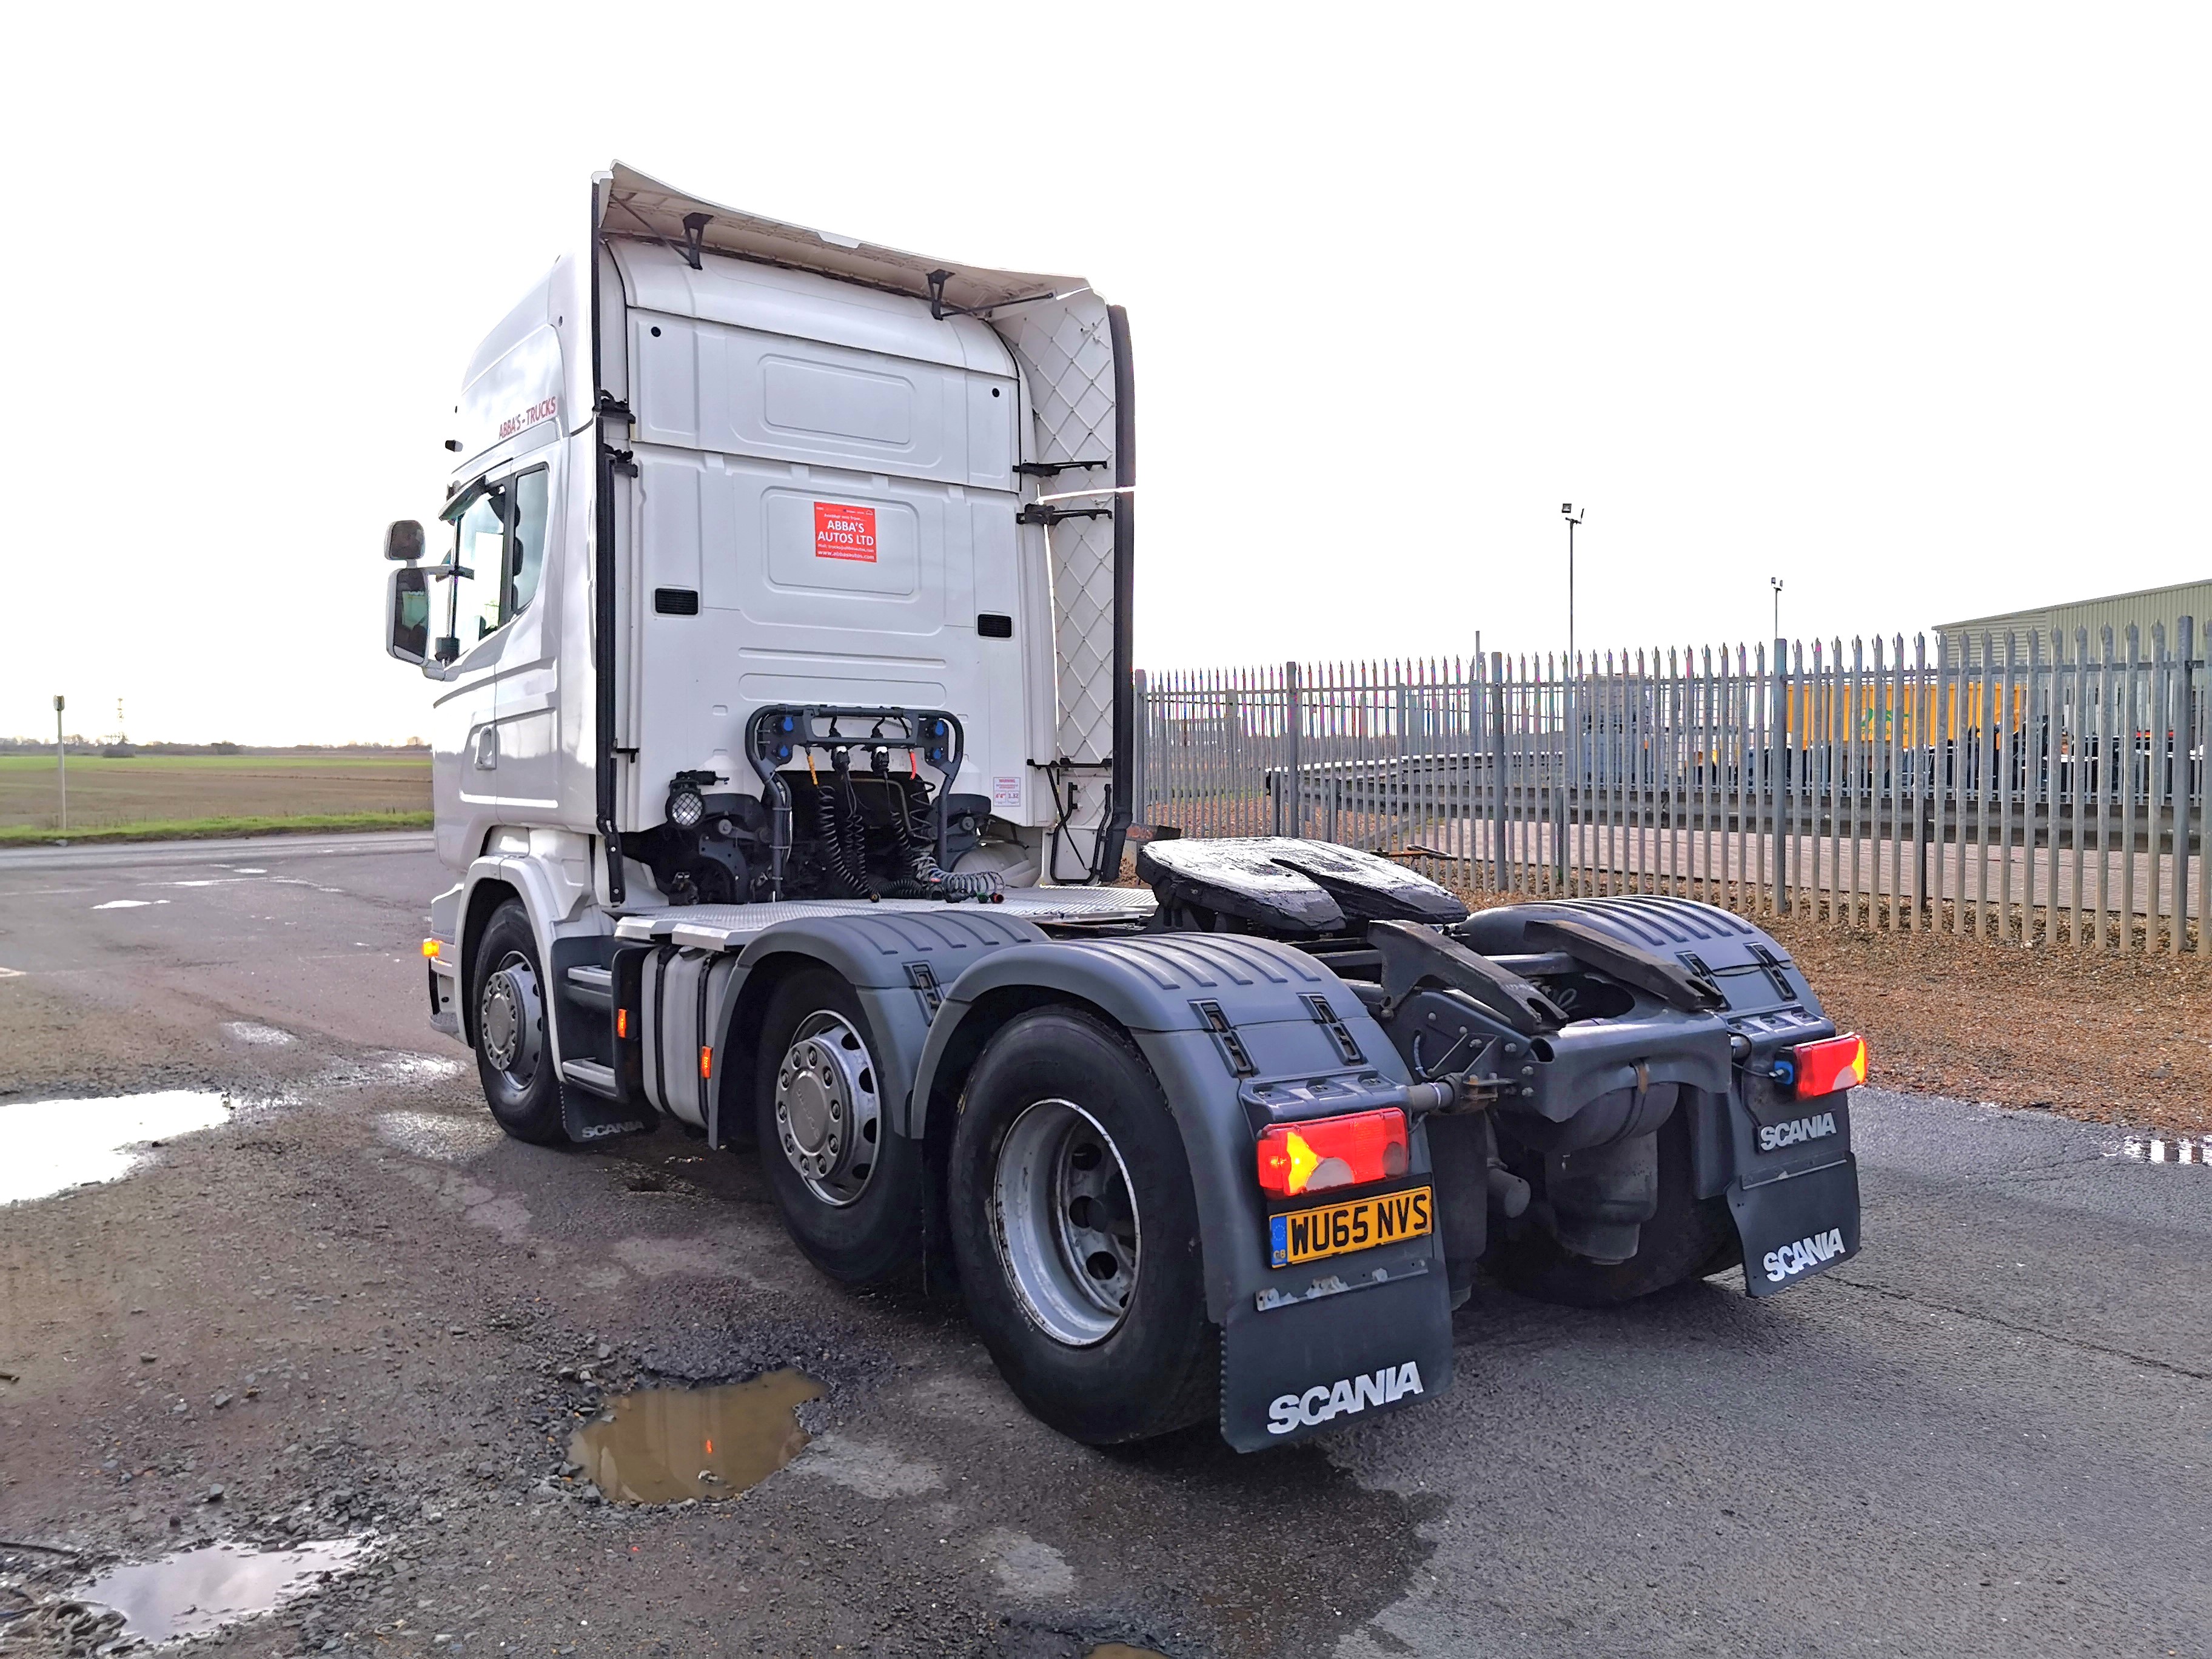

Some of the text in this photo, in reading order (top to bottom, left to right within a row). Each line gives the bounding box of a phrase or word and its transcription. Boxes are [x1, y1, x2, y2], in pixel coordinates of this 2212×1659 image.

[498, 414, 521, 440] ABBA'S
[526, 396, 556, 425] TRUCKS
[818, 531, 874, 546] AUTOS LTD
[827, 520, 865, 533] ABBA'S
[581, 1121, 645, 1138] SCANIA
[1760, 1112, 1837, 1151] SCANIA
[1291, 1193, 1427, 1256] WU65 NVS
[1763, 1228, 1846, 1282] SCANIA
[1267, 1361, 1424, 1435] SCANIA
